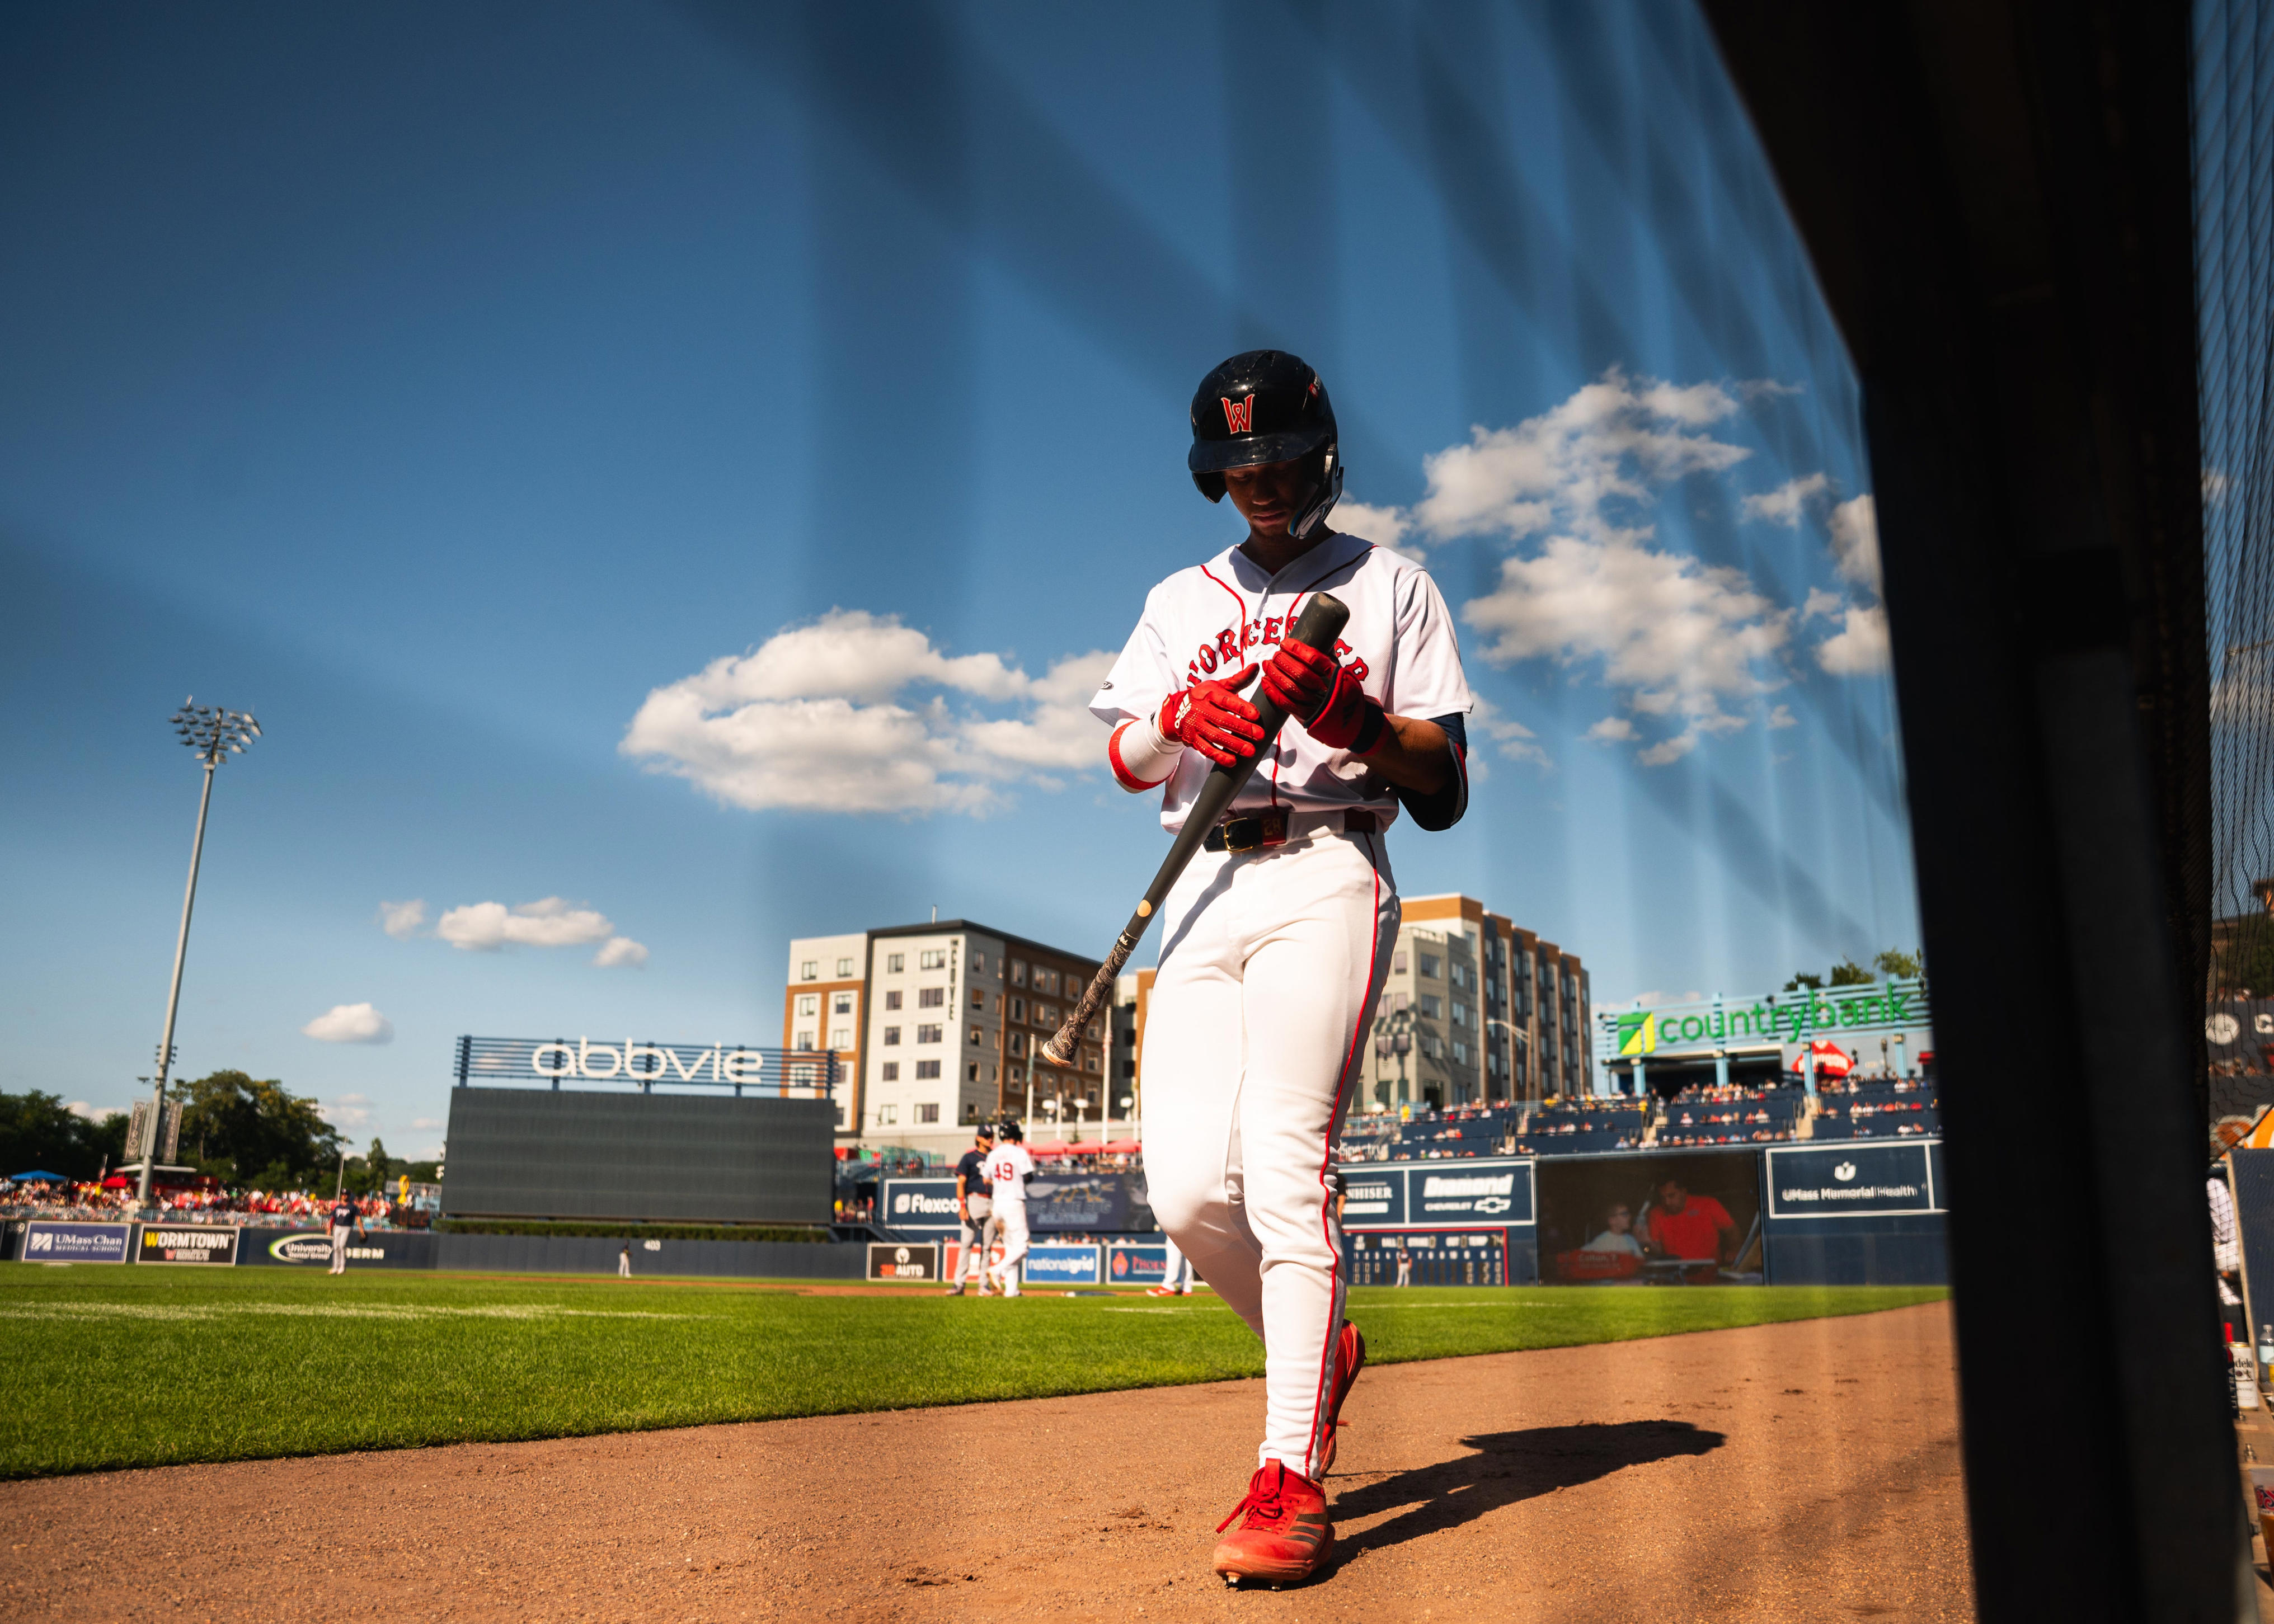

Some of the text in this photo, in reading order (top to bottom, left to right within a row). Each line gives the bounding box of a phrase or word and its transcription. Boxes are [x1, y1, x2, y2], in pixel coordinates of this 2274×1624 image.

[1221, 394, 1255, 435] W
[1659, 982, 1912, 1043] countrybank
[532, 1035, 764, 1084] abbvie
[994, 1162, 1013, 1181] 49
[912, 1194, 961, 1213] flexco
[56, 1233, 123, 1245] UMass Chan
[144, 1232, 230, 1249] WORMTOWN
[2235, 1358, 2253, 1368] delo
